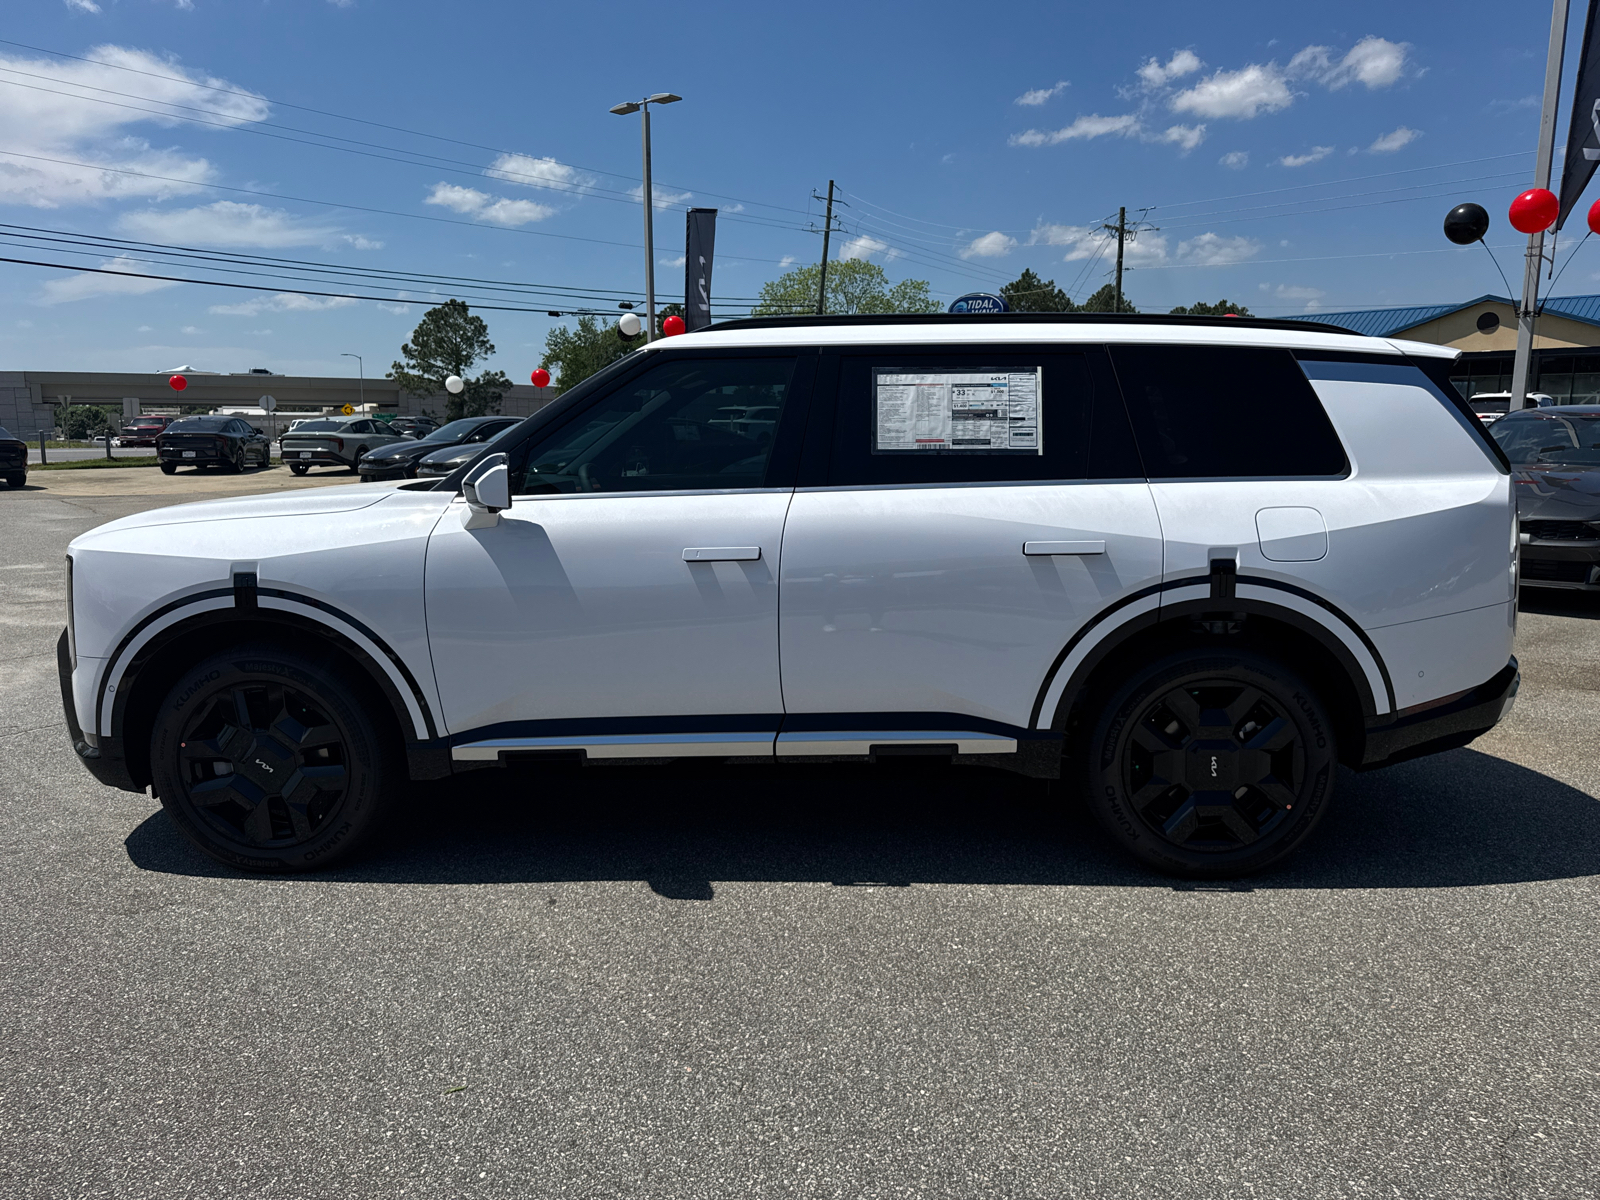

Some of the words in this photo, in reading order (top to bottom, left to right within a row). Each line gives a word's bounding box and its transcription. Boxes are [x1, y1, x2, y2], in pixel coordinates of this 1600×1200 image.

[968, 299, 993, 309] TIDAL
[173, 670, 221, 711] KUMHO
[1244, 664, 1277, 681] OUTSIDE
[1292, 691, 1326, 749] KUMHO
[1105, 785, 1141, 840] KUMHO
[304, 821, 352, 860] KUMHO
